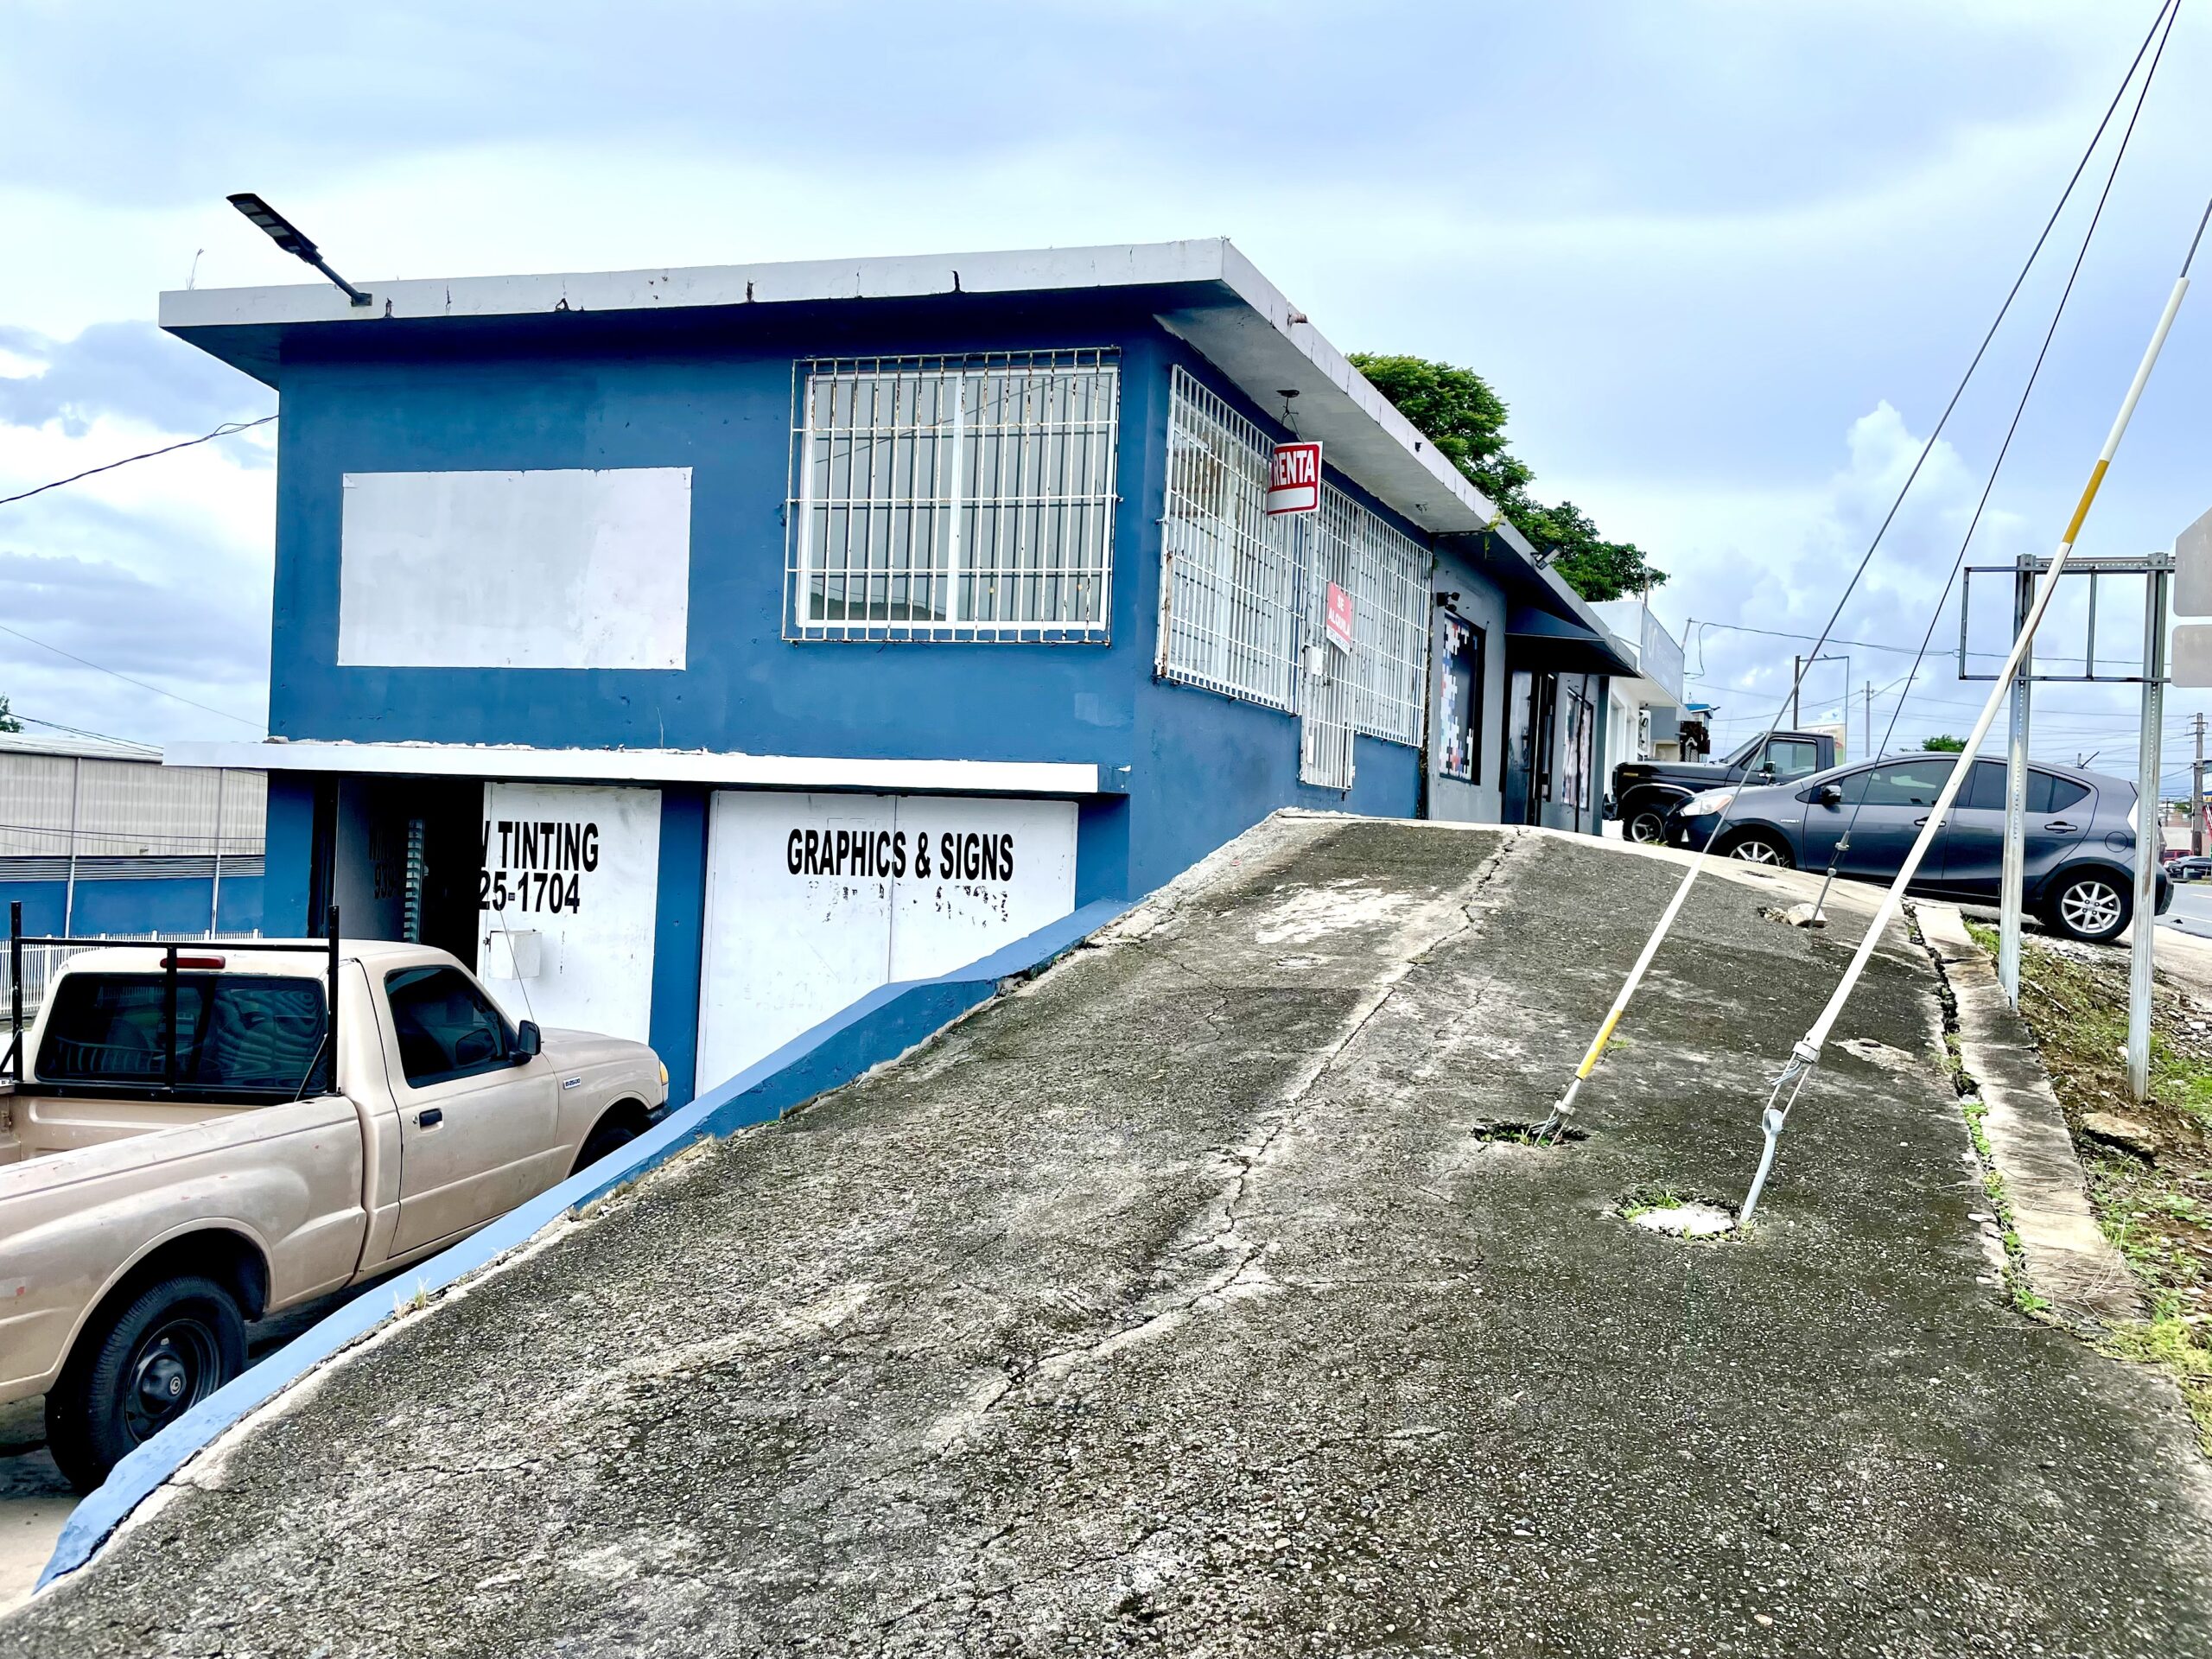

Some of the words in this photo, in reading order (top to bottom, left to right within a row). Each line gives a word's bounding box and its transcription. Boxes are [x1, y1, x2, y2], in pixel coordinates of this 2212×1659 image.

[1274, 449, 1315, 486] RENTA
[498, 821, 599, 872] TINTING
[787, 828, 906, 878] GRAPHICS
[914, 831, 931, 879] &
[939, 832, 1014, 881] SIGNS
[480, 870, 580, 914] 25-1704
